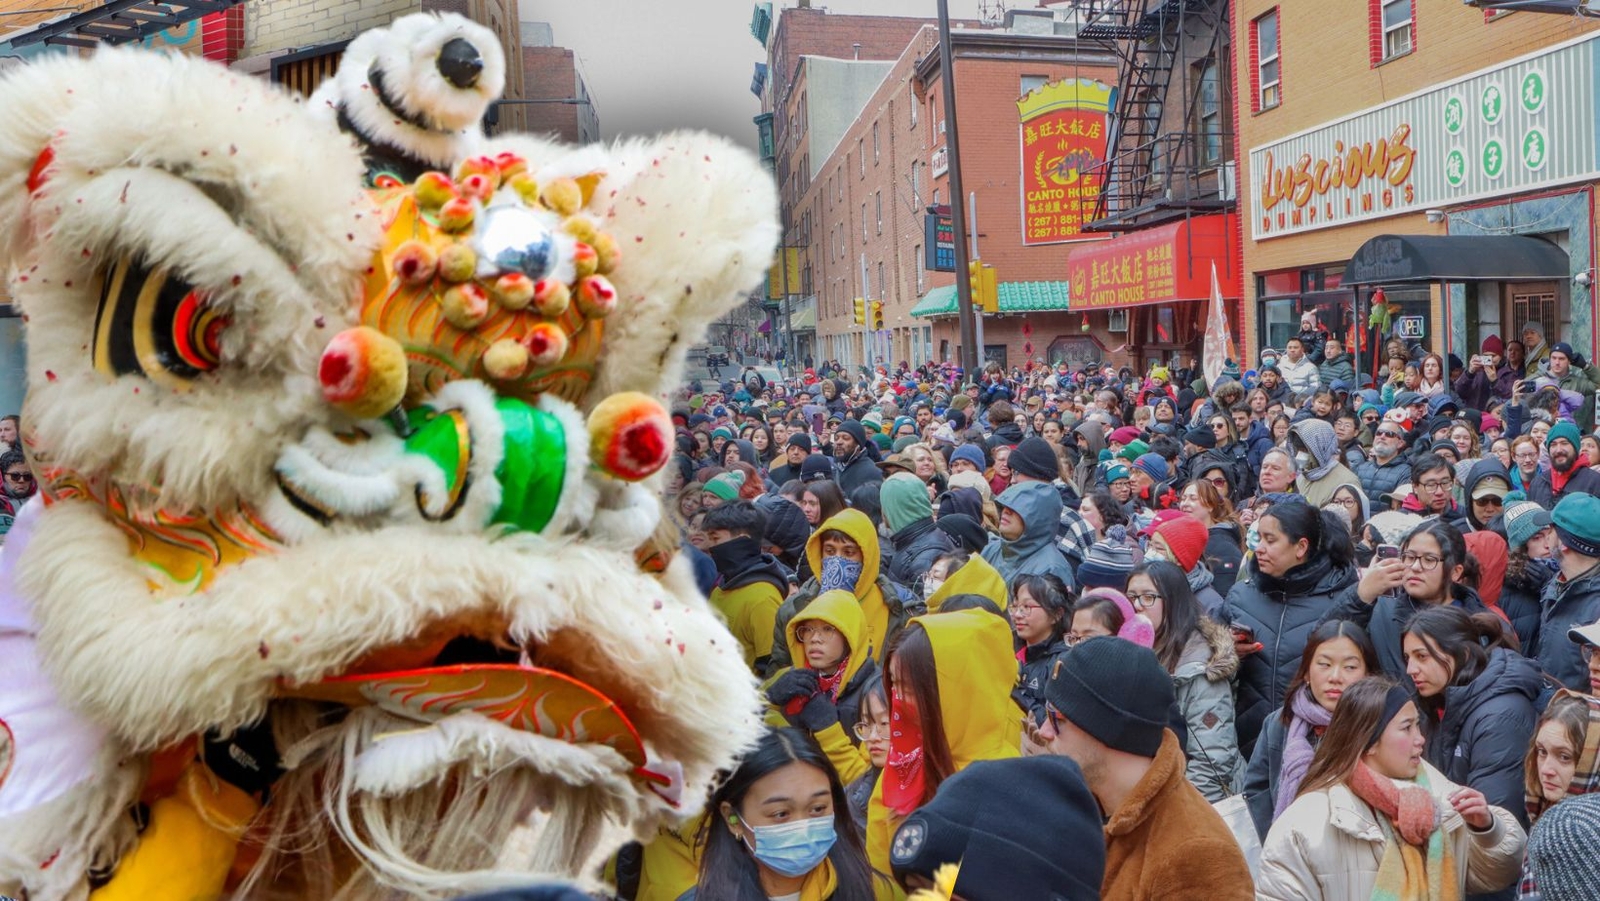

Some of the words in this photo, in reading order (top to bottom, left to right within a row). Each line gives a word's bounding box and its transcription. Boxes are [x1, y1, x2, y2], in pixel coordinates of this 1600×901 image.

[1262, 124, 1417, 211] Luscious
[1027, 189, 1065, 202] CANTO
[1263, 184, 1414, 232] DUMPLINGS
[1090, 251, 1144, 290] 嘉旺大飯店
[1090, 288, 1116, 306] CANTO
[1117, 285, 1145, 304] HOUSE
[1401, 319, 1423, 335] OPEN
